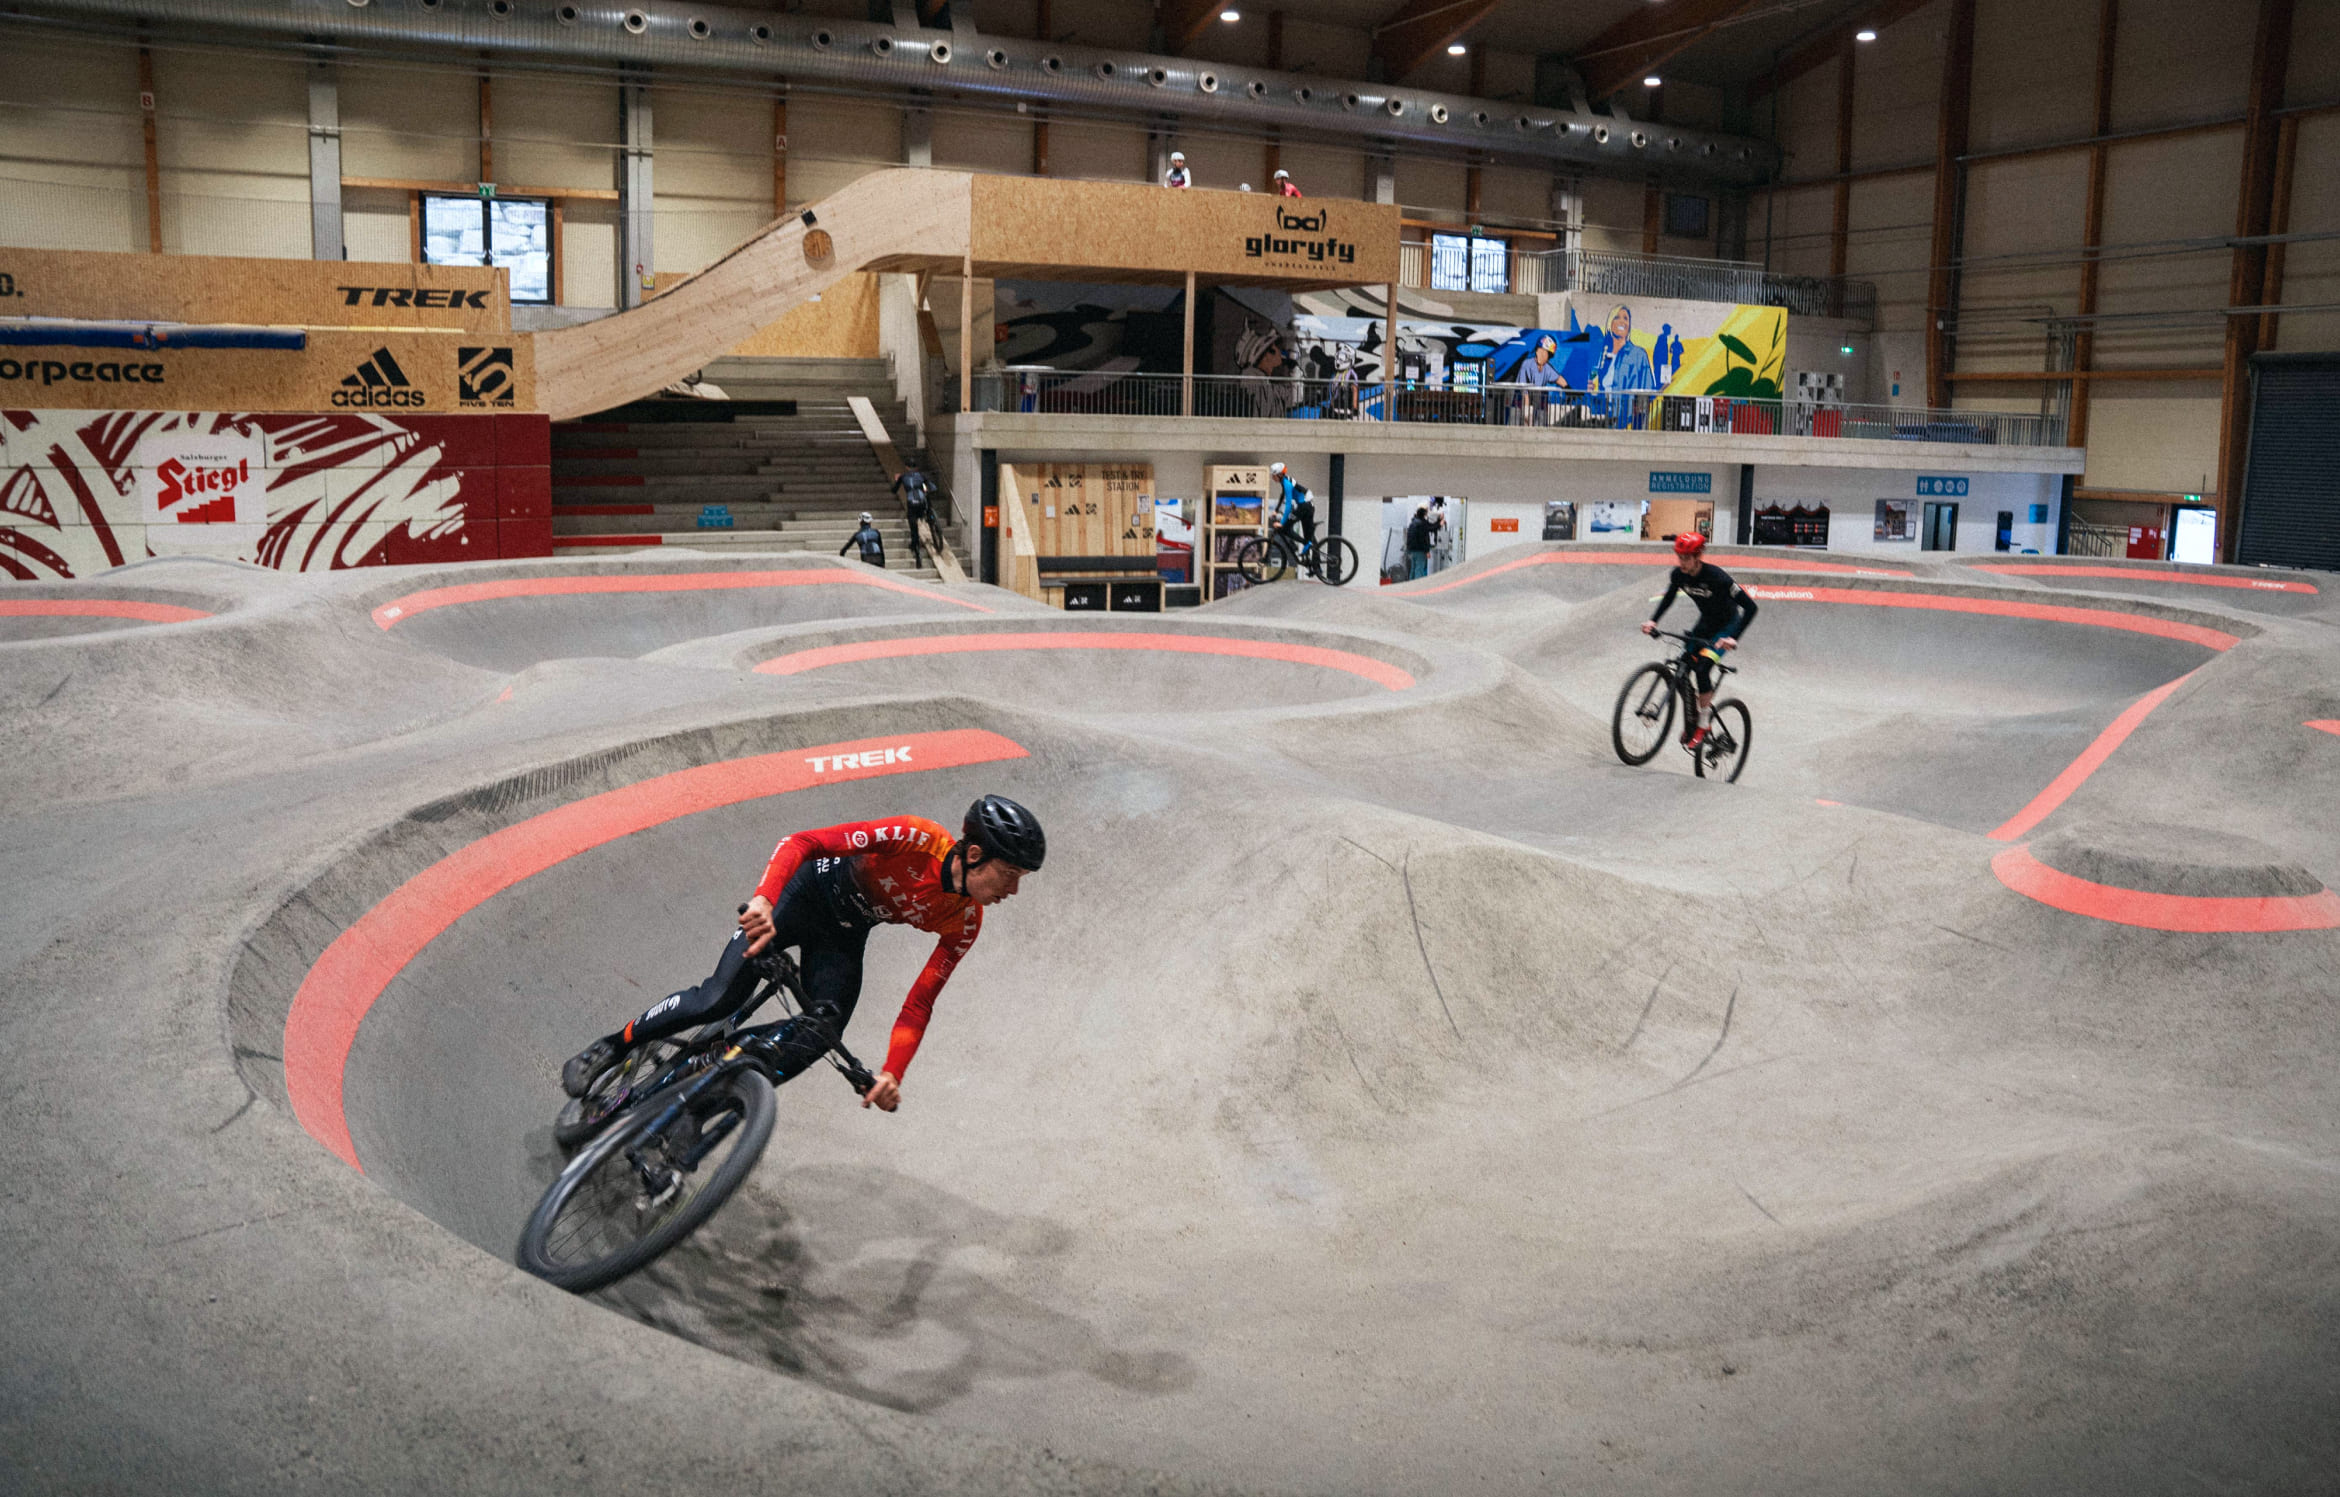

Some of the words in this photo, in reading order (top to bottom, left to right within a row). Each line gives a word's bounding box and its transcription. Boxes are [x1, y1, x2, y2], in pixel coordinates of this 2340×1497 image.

[1246, 233, 1354, 263] gloryfy
[337, 286, 491, 309] TREK
[331, 384, 425, 407] adidas
[459, 400, 486, 408] FIVE
[490, 400, 514, 408] TEN
[157, 457, 249, 511] Stiegl
[1102, 470, 1121, 480] TEST
[1107, 481, 1140, 491] STATION
[1651, 481, 1710, 490] REGISTRATION
[805, 746, 912, 773] TREK
